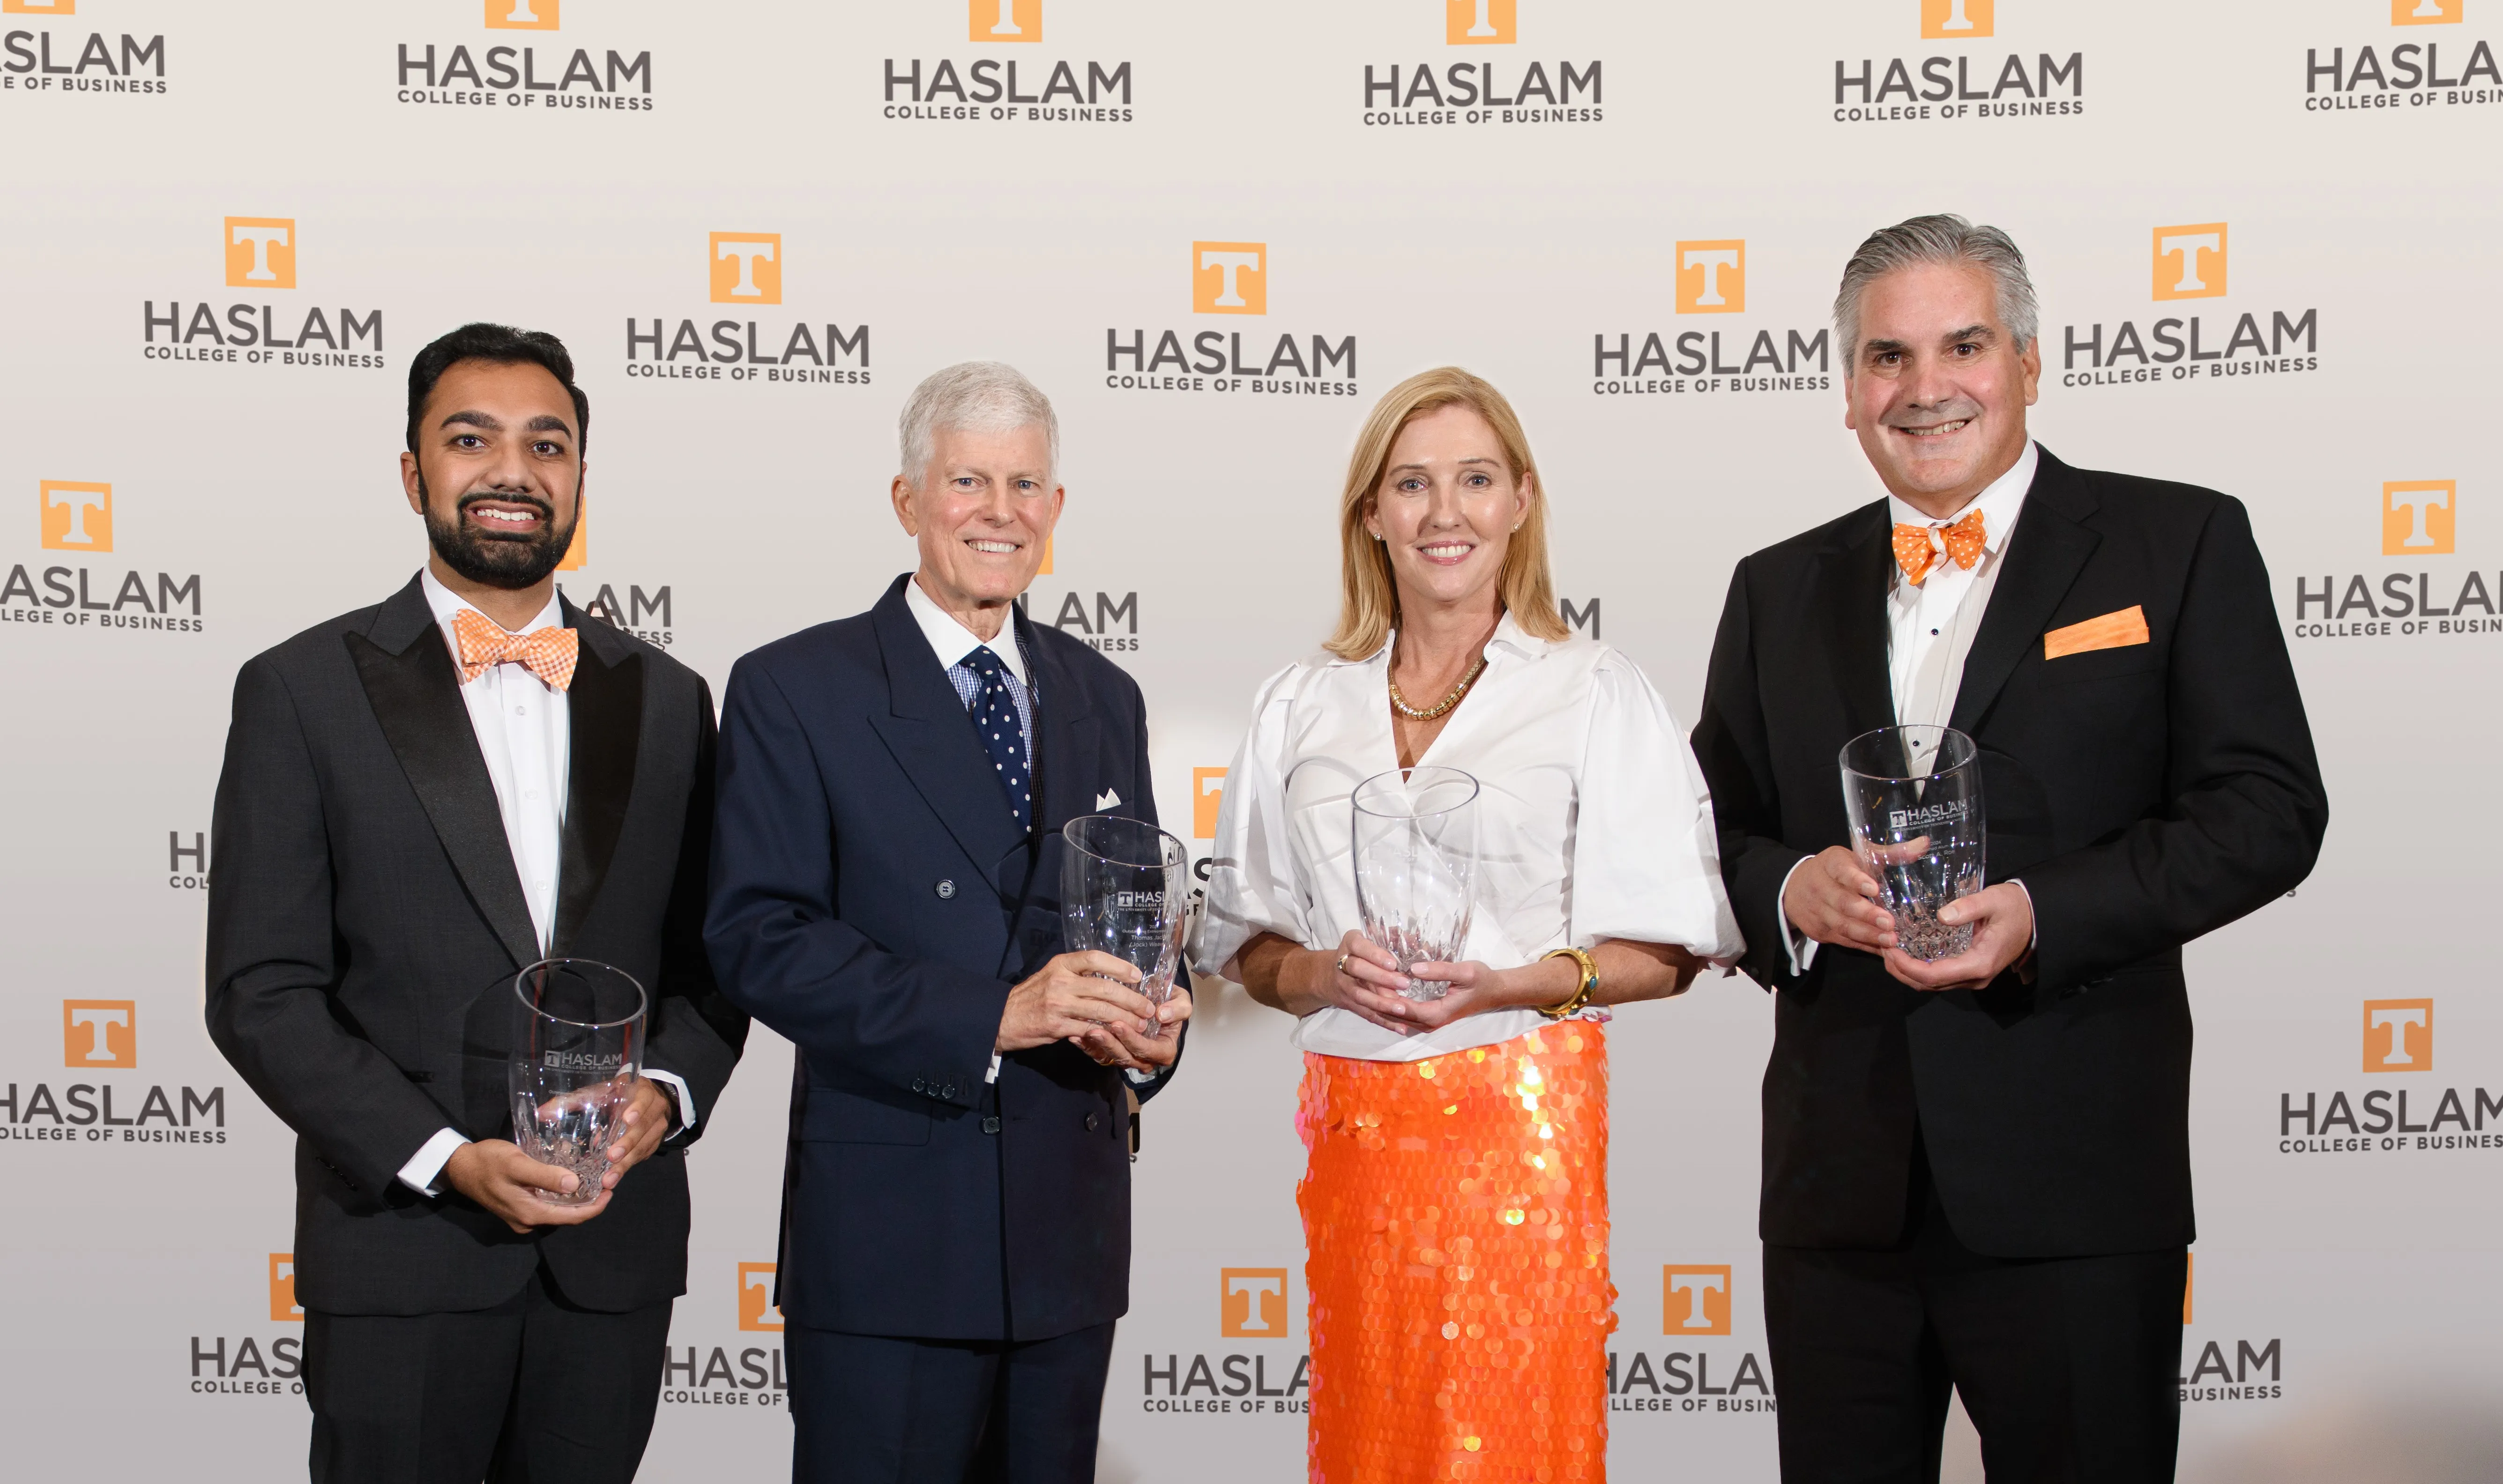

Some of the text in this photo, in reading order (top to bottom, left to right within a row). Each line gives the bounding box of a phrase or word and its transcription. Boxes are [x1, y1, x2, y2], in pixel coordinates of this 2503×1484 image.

[0, 30, 164, 76] SLAM
[398, 44, 651, 94] HASLAM
[1835, 52, 2082, 104] HASLAM
[25, 77, 52, 90] OF
[63, 79, 166, 93] BUSINESS
[885, 59, 1131, 104] HASLAM
[1365, 61, 1602, 108] HASLAM
[398, 90, 652, 111] COLLEGE OF BUSINESS
[2305, 94, 2399, 111] COLLEGE
[2410, 92, 2437, 106] OF
[884, 106, 1132, 122] COLLEGE OF BUSINESS
[1364, 109, 1603, 125] COLLEGE OF BUSINESS
[1834, 101, 2083, 122] COLLEGE OF BUSINESS
[144, 301, 382, 351] HASLAM
[627, 318, 869, 367] HASLAM
[2064, 309, 2317, 369] HASLAM
[144, 346, 384, 368] COLLEGE OF BUSINESS
[1107, 329, 1356, 378] HASLAM
[1595, 329, 1828, 377] HASLAM
[627, 364, 870, 384] COLLEGE OF BUSINESS
[2063, 357, 2317, 387] COLLEGE OF BUSINESS
[1107, 376, 1357, 395] COLLEGE OF BUSINESS
[1594, 377, 1829, 394] COLLEGE OF BUSINESS
[2296, 571, 2503, 620] HASLA
[63, 612, 90, 625] OF
[100, 615, 202, 632] BUSINESS
[2295, 622, 2391, 638] COLLEGE
[2402, 621, 2428, 634] OF
[1907, 799, 1968, 821] HASLAM
[562, 1053, 622, 1065] HASLAM
[87, 1129, 113, 1141] OF
[124, 1130, 226, 1144] BUSINESS
[2280, 1138, 2371, 1153] COLLEGE
[2381, 1137, 2406, 1150] OF
[191, 1380, 281, 1394] COLLEGE
[664, 1390, 782, 1405] COLLEGE OF
[1143, 1400, 1231, 1413] COLLEGE
[1241, 1401, 1265, 1413] OF
[1682, 1399, 1707, 1411] OF
